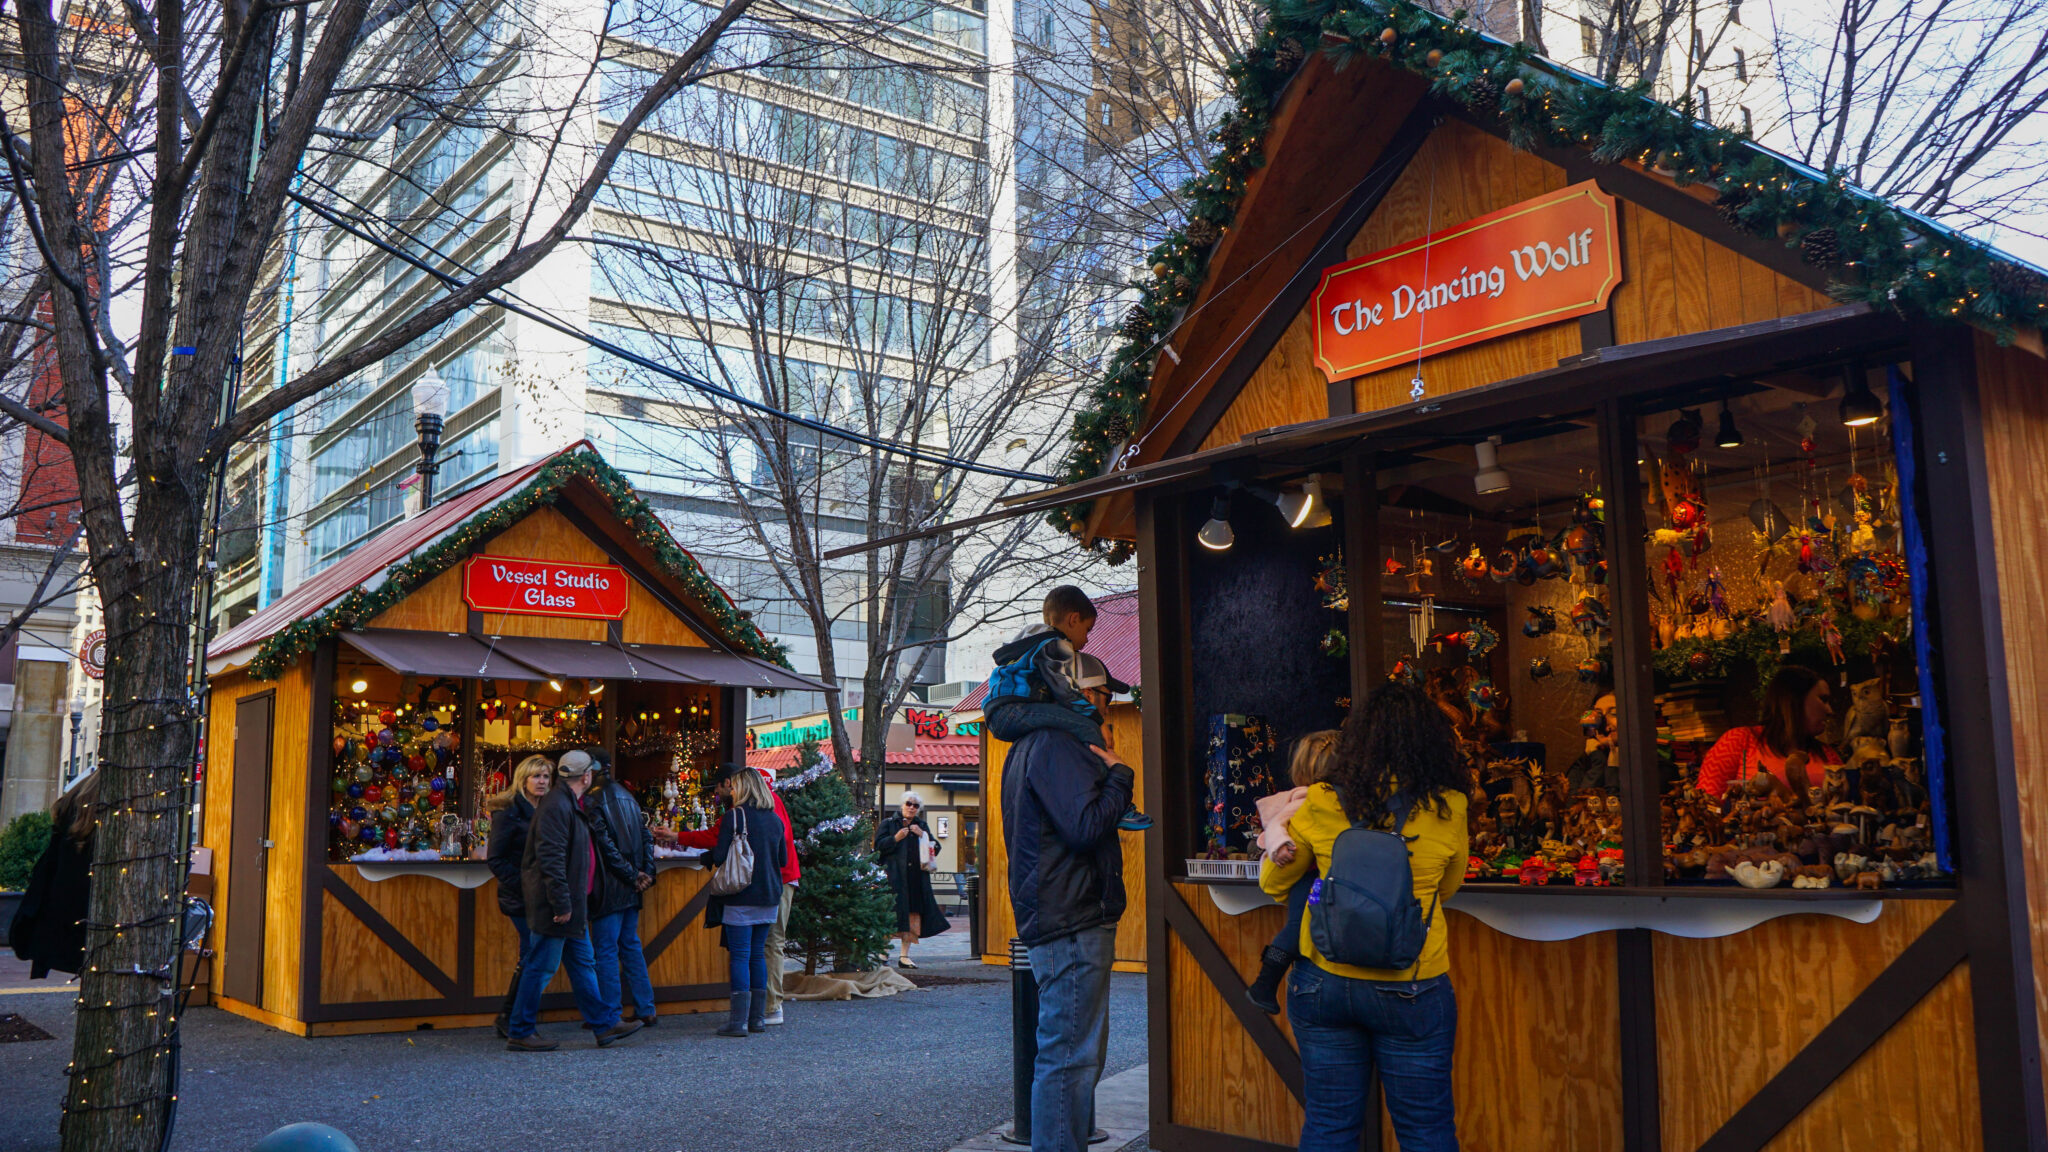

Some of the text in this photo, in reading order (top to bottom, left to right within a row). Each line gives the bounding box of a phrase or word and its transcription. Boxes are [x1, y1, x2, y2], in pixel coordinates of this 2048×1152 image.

[1331, 227, 1594, 336] The Dancing Wolf
[491, 564, 610, 590] Vessel Studio
[524, 587, 576, 608] Glass
